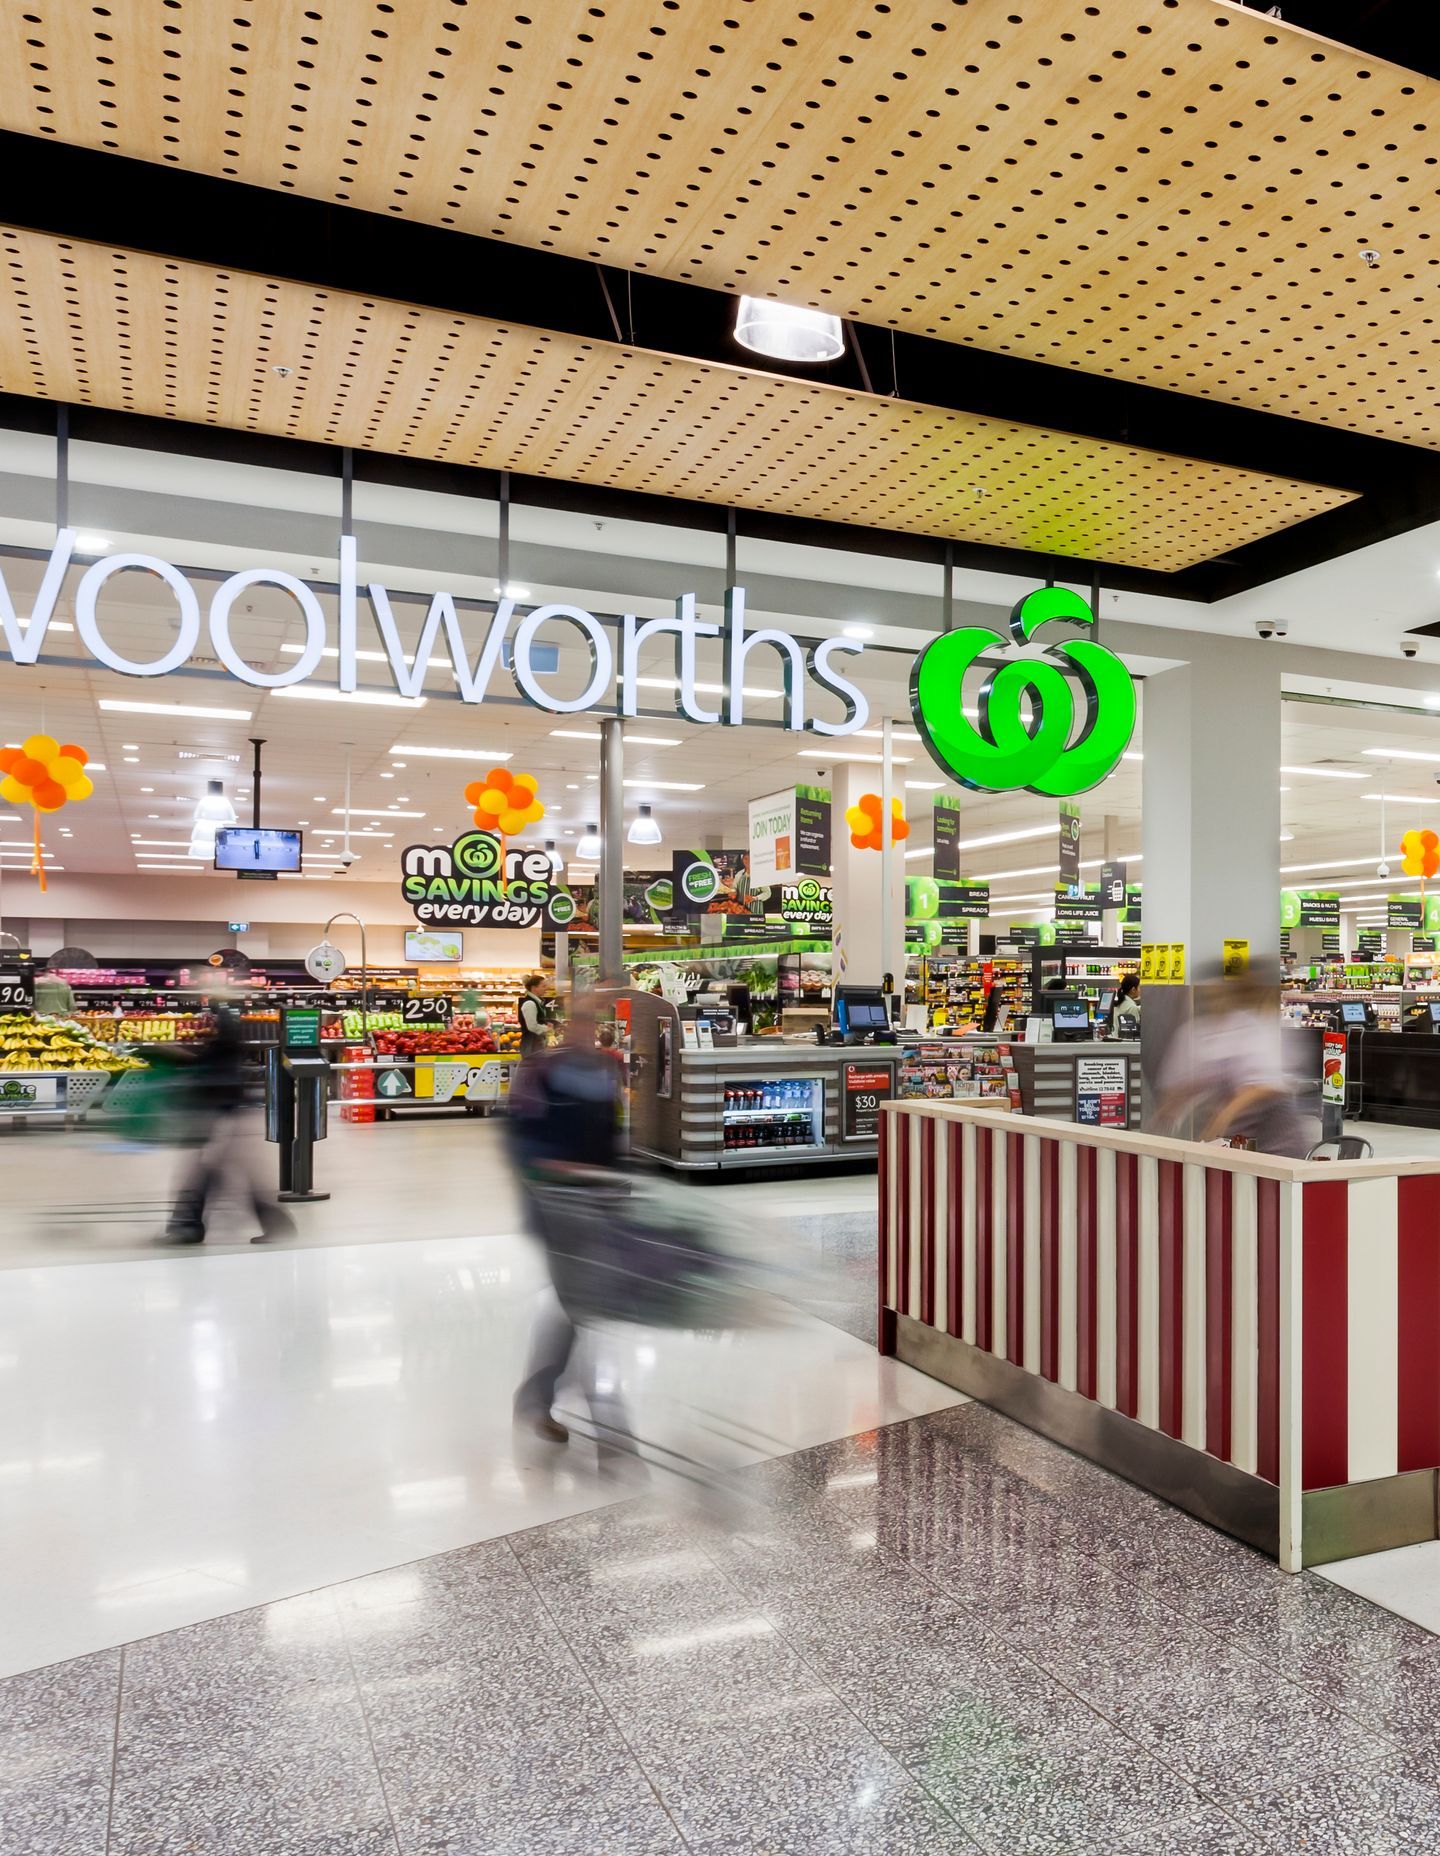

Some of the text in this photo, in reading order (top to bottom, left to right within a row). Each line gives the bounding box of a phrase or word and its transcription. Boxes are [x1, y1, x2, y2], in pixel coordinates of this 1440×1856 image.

[752, 813, 792, 840] JOIN TODAY
[405, 833, 551, 881] more
[688, 871, 713, 881] FRESH
[694, 878, 713, 888] FREE
[405, 876, 549, 904] SAVINGS
[782, 899, 833, 912] SAVING
[919, 893, 928, 910] 1
[417, 900, 538, 925] every day
[783, 910, 833, 921] every day
[1284, 904, 1294, 920] 3
[1430, 910, 1440, 922] 4
[855, 1095, 876, 1109] $30
